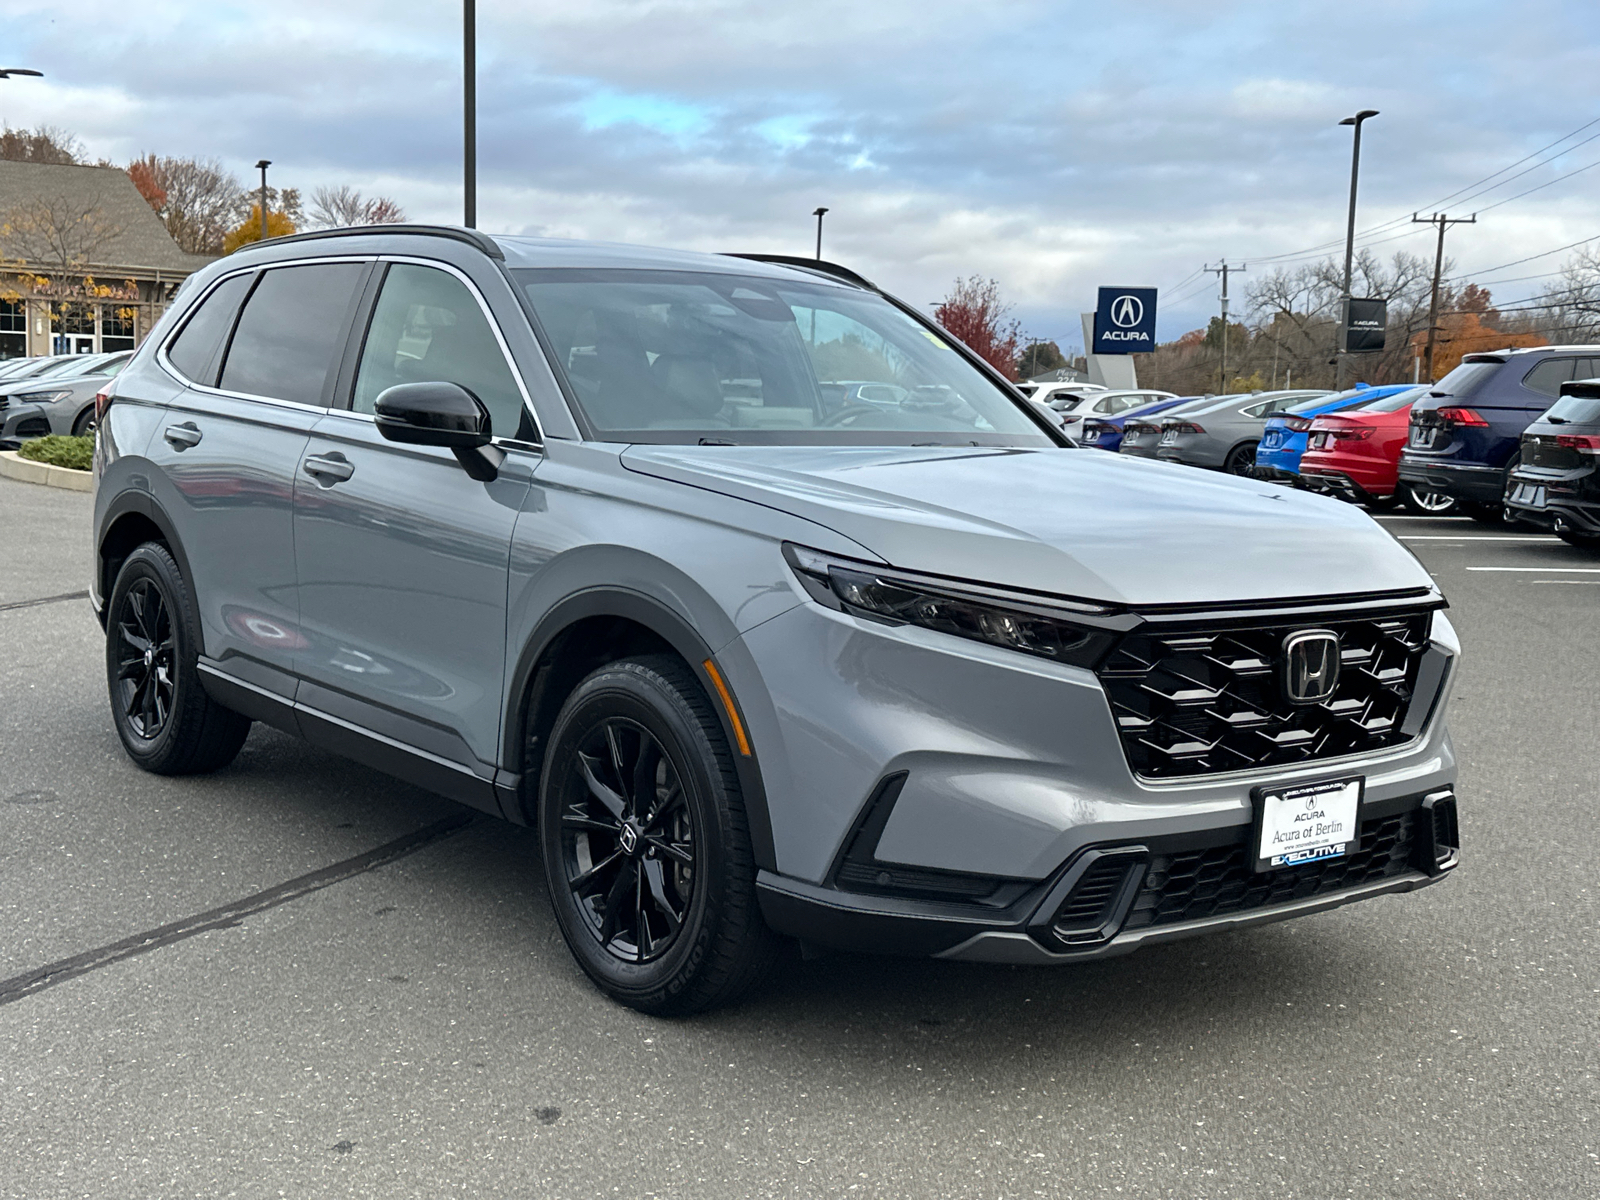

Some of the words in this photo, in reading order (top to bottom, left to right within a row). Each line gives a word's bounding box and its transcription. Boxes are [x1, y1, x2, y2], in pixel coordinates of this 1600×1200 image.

[1102, 331, 1149, 341] ACURA
[1056, 369, 1078, 377] Plaza
[1294, 811, 1325, 822] ACURA
[1272, 830, 1300, 844] Acura
[1302, 826, 1313, 839] of
[1315, 821, 1342, 836] Berlin
[1271, 843, 1345, 866] EXECUTIVE
